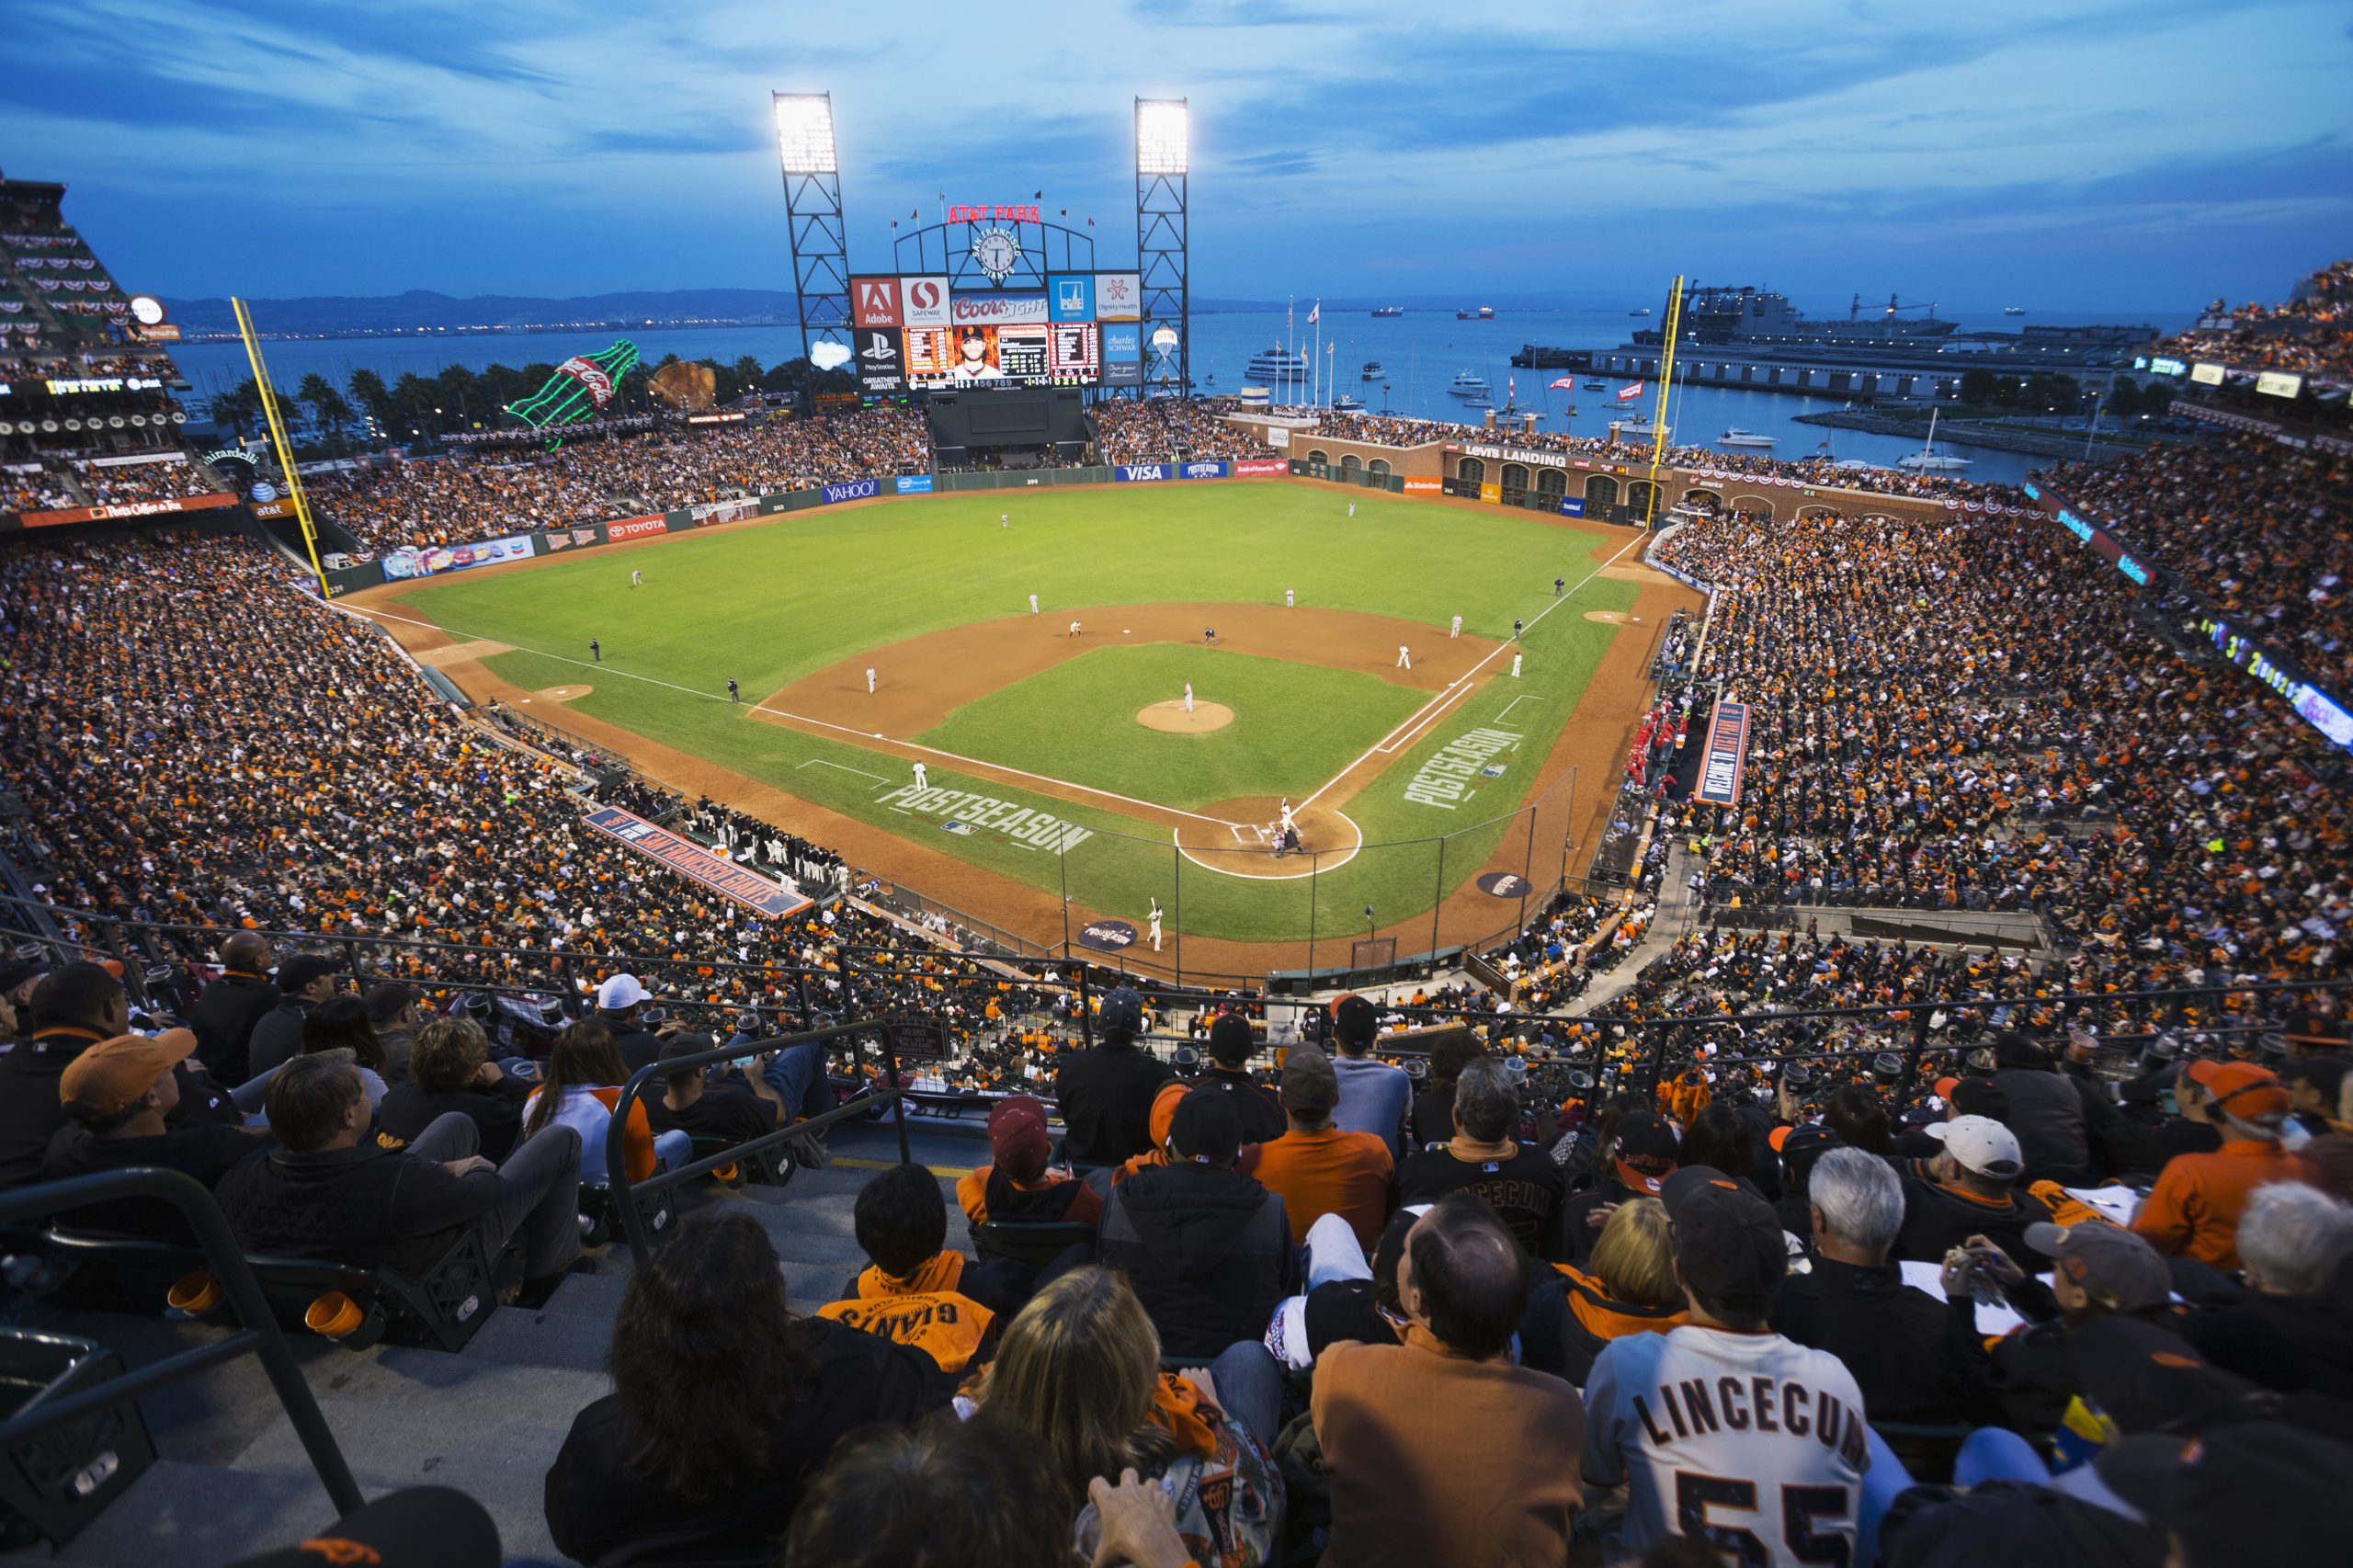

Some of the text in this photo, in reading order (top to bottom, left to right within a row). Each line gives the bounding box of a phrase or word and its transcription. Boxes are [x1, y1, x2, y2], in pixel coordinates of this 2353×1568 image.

[948, 205, 1040, 224] AT&T PARK
[972, 227, 1021, 257] SAN FRANCISCO
[982, 267, 1015, 279] GIANTS
[953, 297, 1006, 320] Coors
[865, 313, 893, 324] Adobe
[1108, 335, 1136, 345] charles
[863, 376, 901, 384] GREATNESS
[203, 448, 259, 466] hirardelli
[1503, 448, 1566, 468] LANDING
[1124, 466, 1163, 481] VISA
[1188, 464, 1220, 474] POSTSEASON
[826, 481, 875, 502] YAHOO!
[131, 504, 159, 516] Coffee
[166, 500, 183, 511] Tea
[256, 505, 282, 517] at&t
[625, 519, 666, 534] TOYOTA
[1704, 719, 1741, 794] WELCOME TO AT&T PARK
[1404, 728, 1524, 810] POSTSEASON
[874, 784, 1094, 856] POSTSEASON
[635, 832, 666, 857] SAN
[659, 843, 732, 883] FRANCISCO
[722, 868, 781, 904] GIANTS
[836, 1302, 959, 1338] GIANTS
[1675, 1470, 1858, 1568] 55
